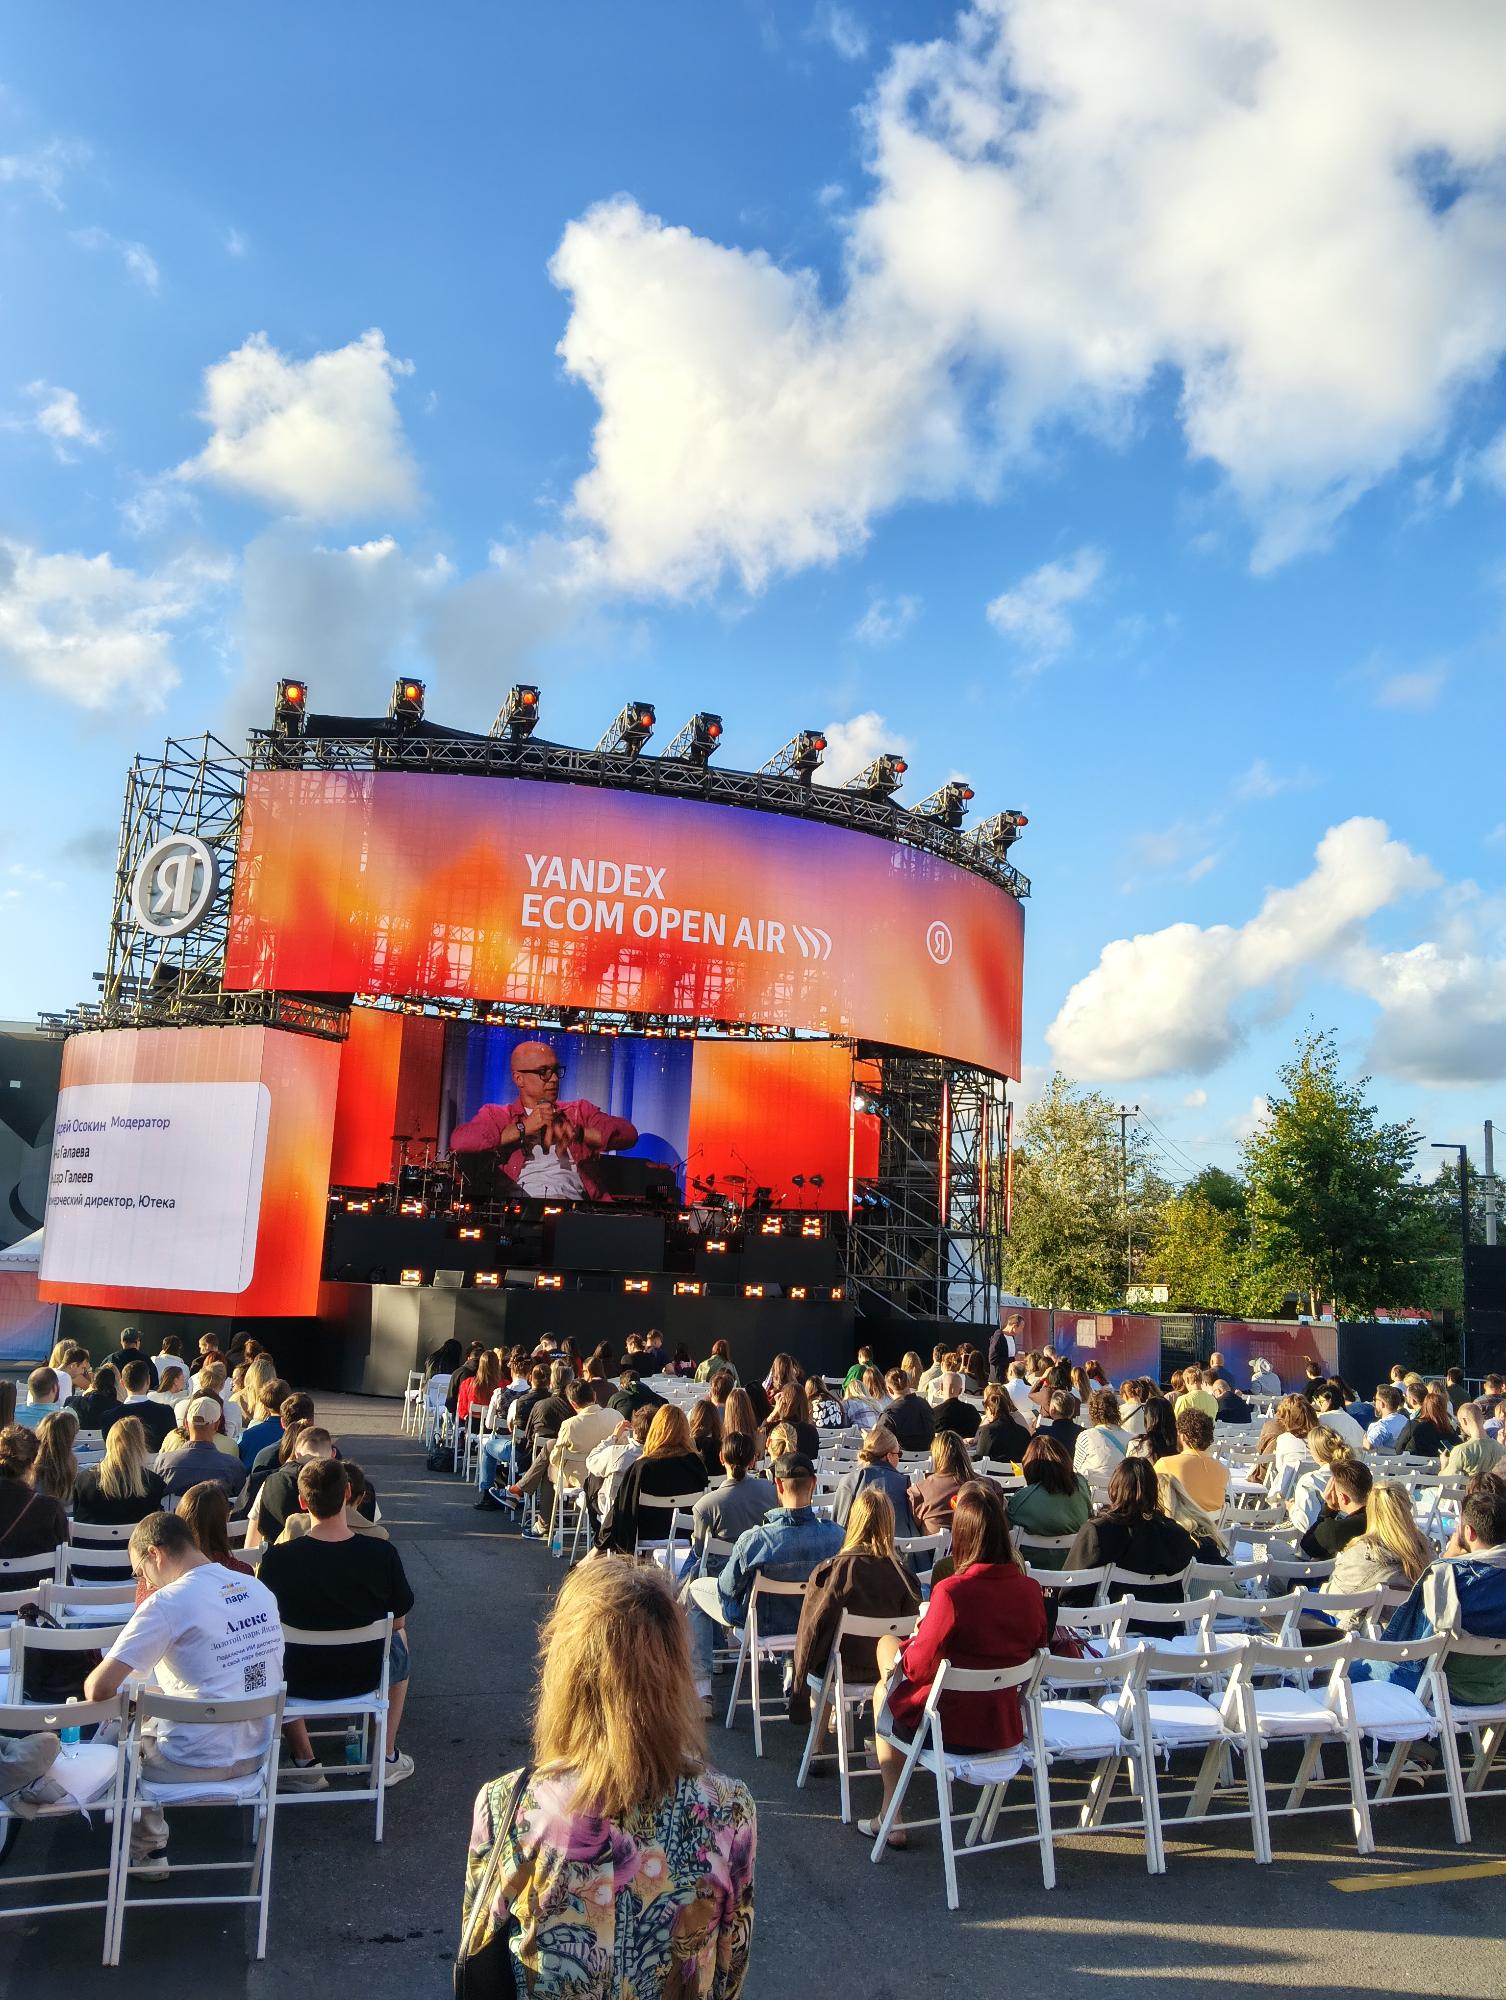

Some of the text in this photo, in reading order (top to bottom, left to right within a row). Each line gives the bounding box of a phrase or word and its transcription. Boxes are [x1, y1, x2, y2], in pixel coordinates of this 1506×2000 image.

[524, 853, 667, 900] YANDEX
[521, 893, 786, 954] ECOM OPEN AIR
[57, 1116, 171, 1136] дрей Осокин Модератор
[60, 1145, 90, 1159] Галаева
[64, 1169, 94, 1184] Галеев
[83, 1195, 135, 1209] директор,
[138, 1195, 176, 1209] Ютека
[225, 1592, 250, 1605] парк
[226, 1612, 268, 1635] Алекс
[242, 1629, 260, 1640] парк
